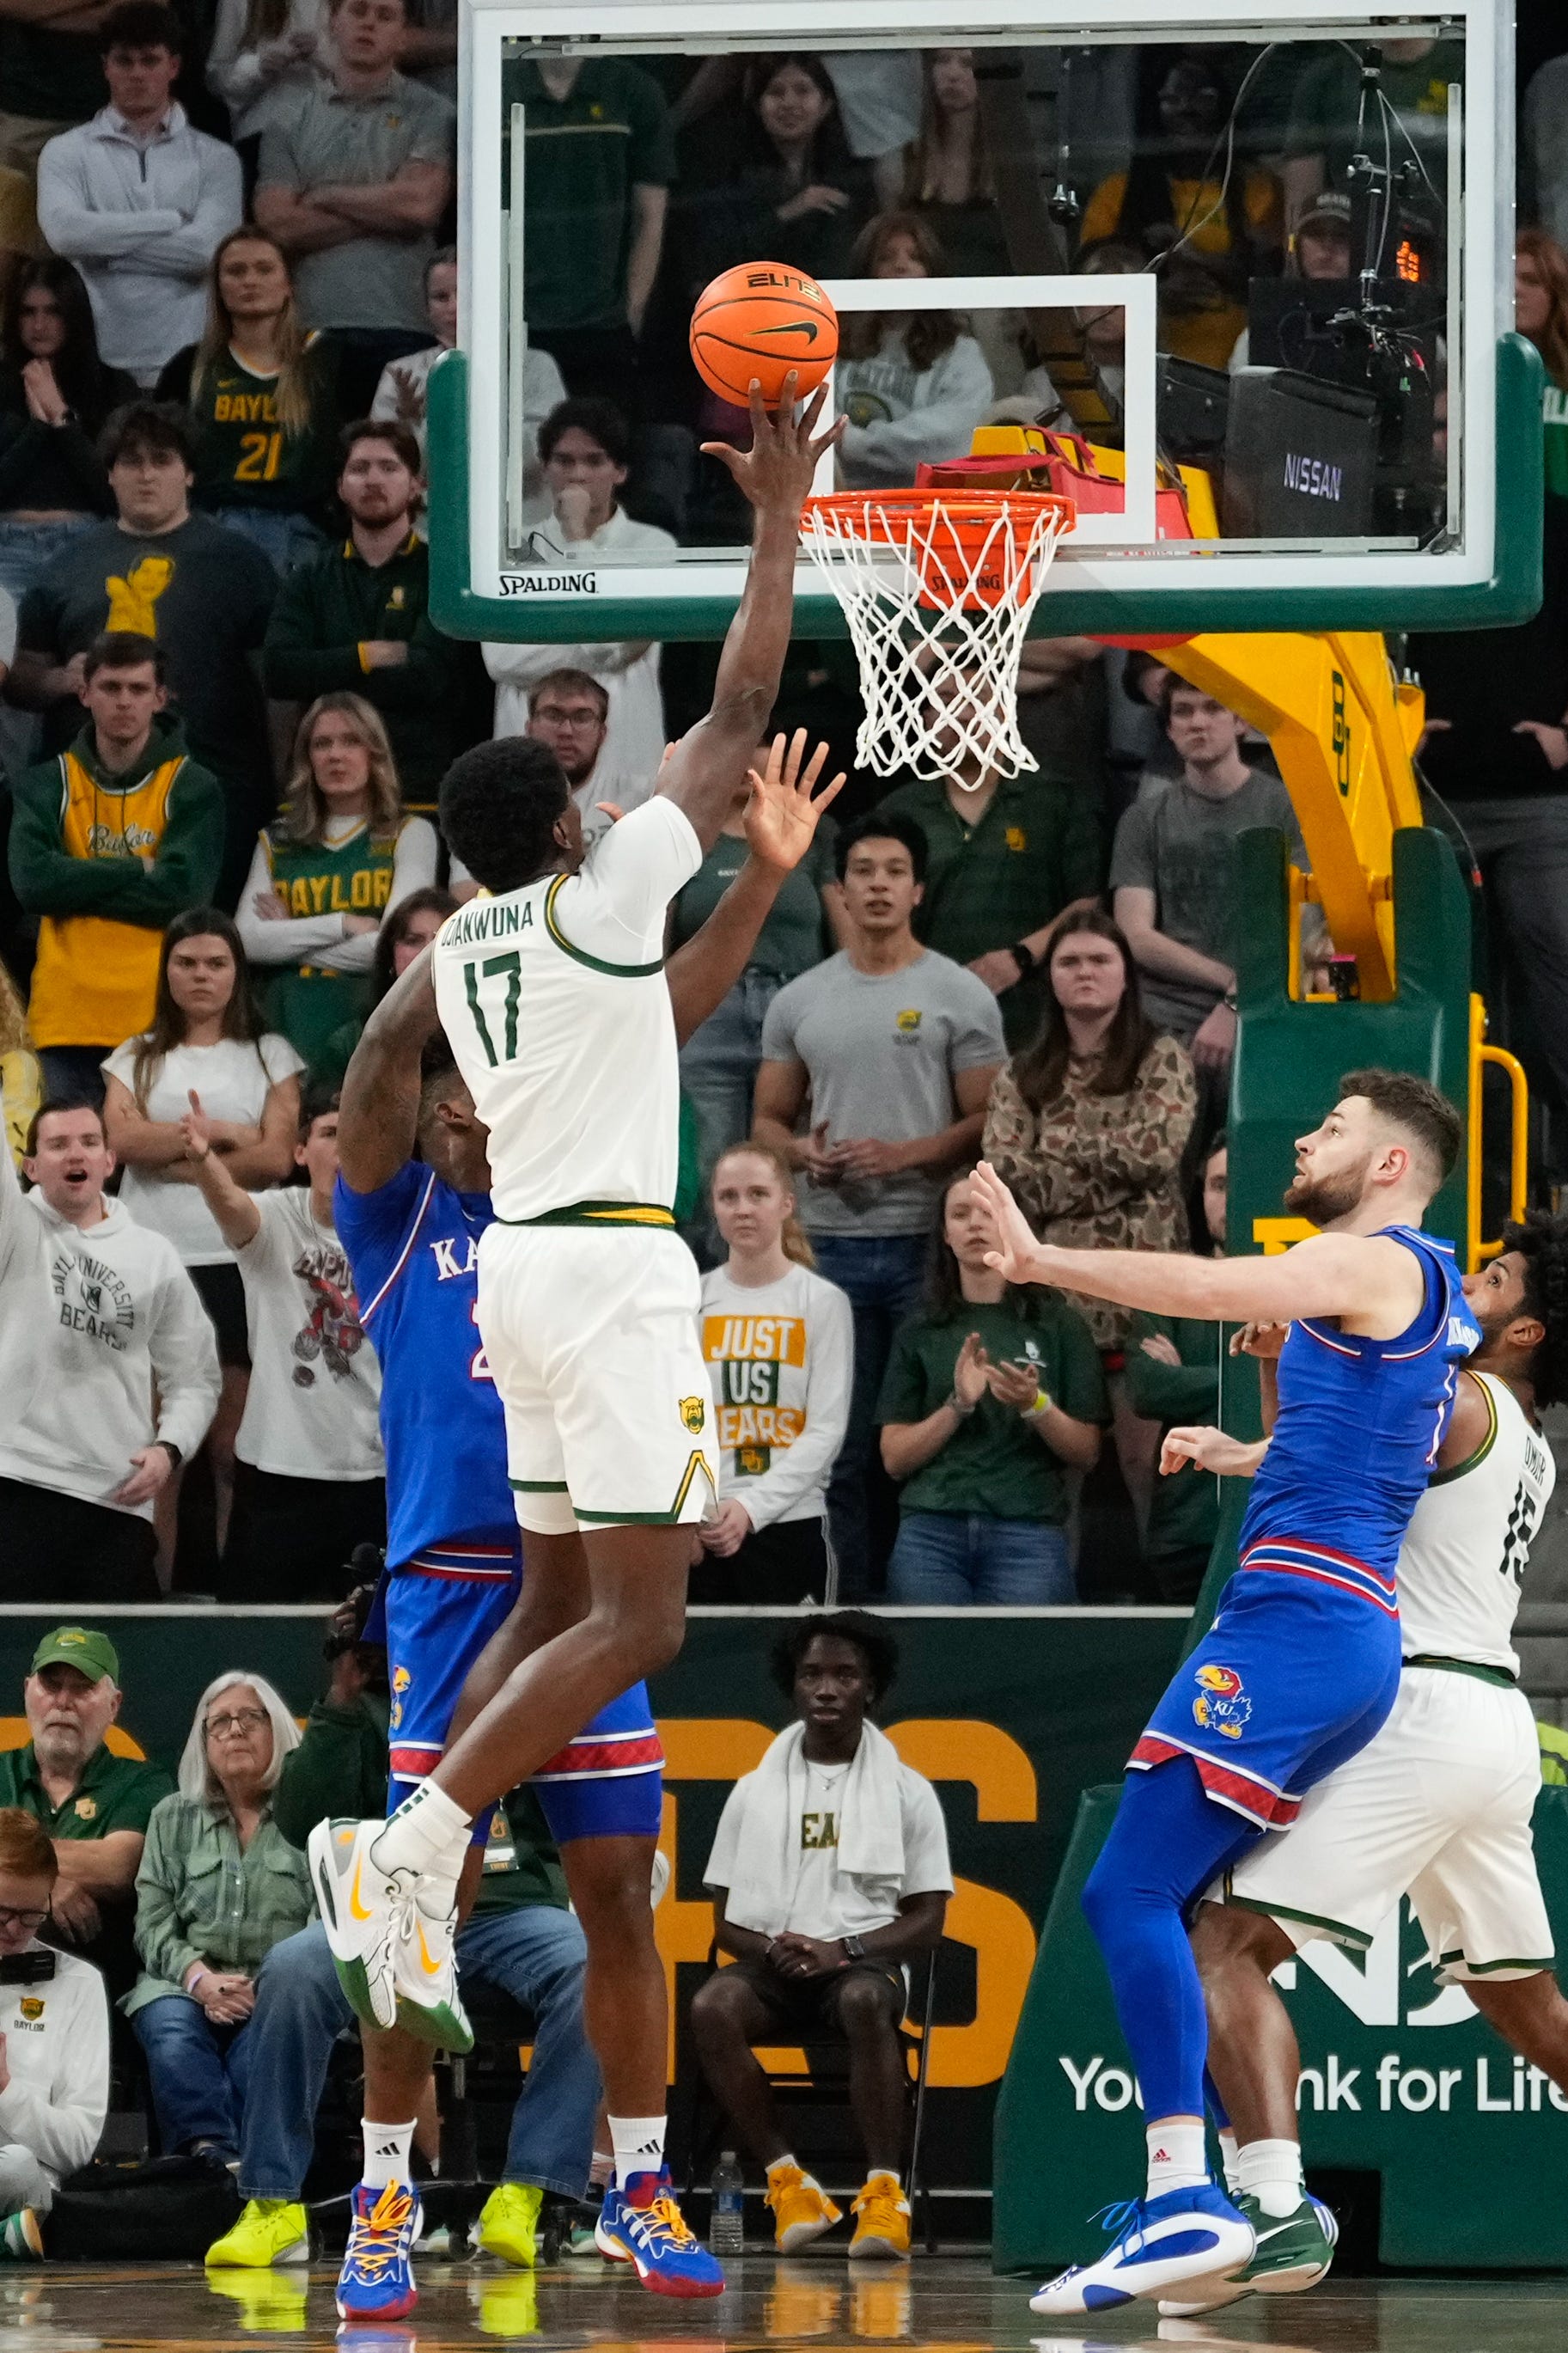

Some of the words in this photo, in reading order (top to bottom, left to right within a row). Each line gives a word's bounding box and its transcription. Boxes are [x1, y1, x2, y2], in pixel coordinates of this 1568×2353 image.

[746, 272, 822, 303] ELITE
[215, 394, 278, 423] BAYL
[235, 433, 282, 480] 21
[1284, 453, 1341, 502] NISSAN
[498, 571, 596, 596] SPALDING
[932, 574, 1001, 592] SPALING
[464, 950, 522, 1068] 17
[711, 1318, 796, 1360] JUST
[730, 1360, 771, 1405] US
[720, 1407, 796, 1446] EARS
[1059, 2058, 1144, 2112] Yo
[1294, 2056, 1362, 2111] nk
[1376, 2056, 1461, 2112] for
